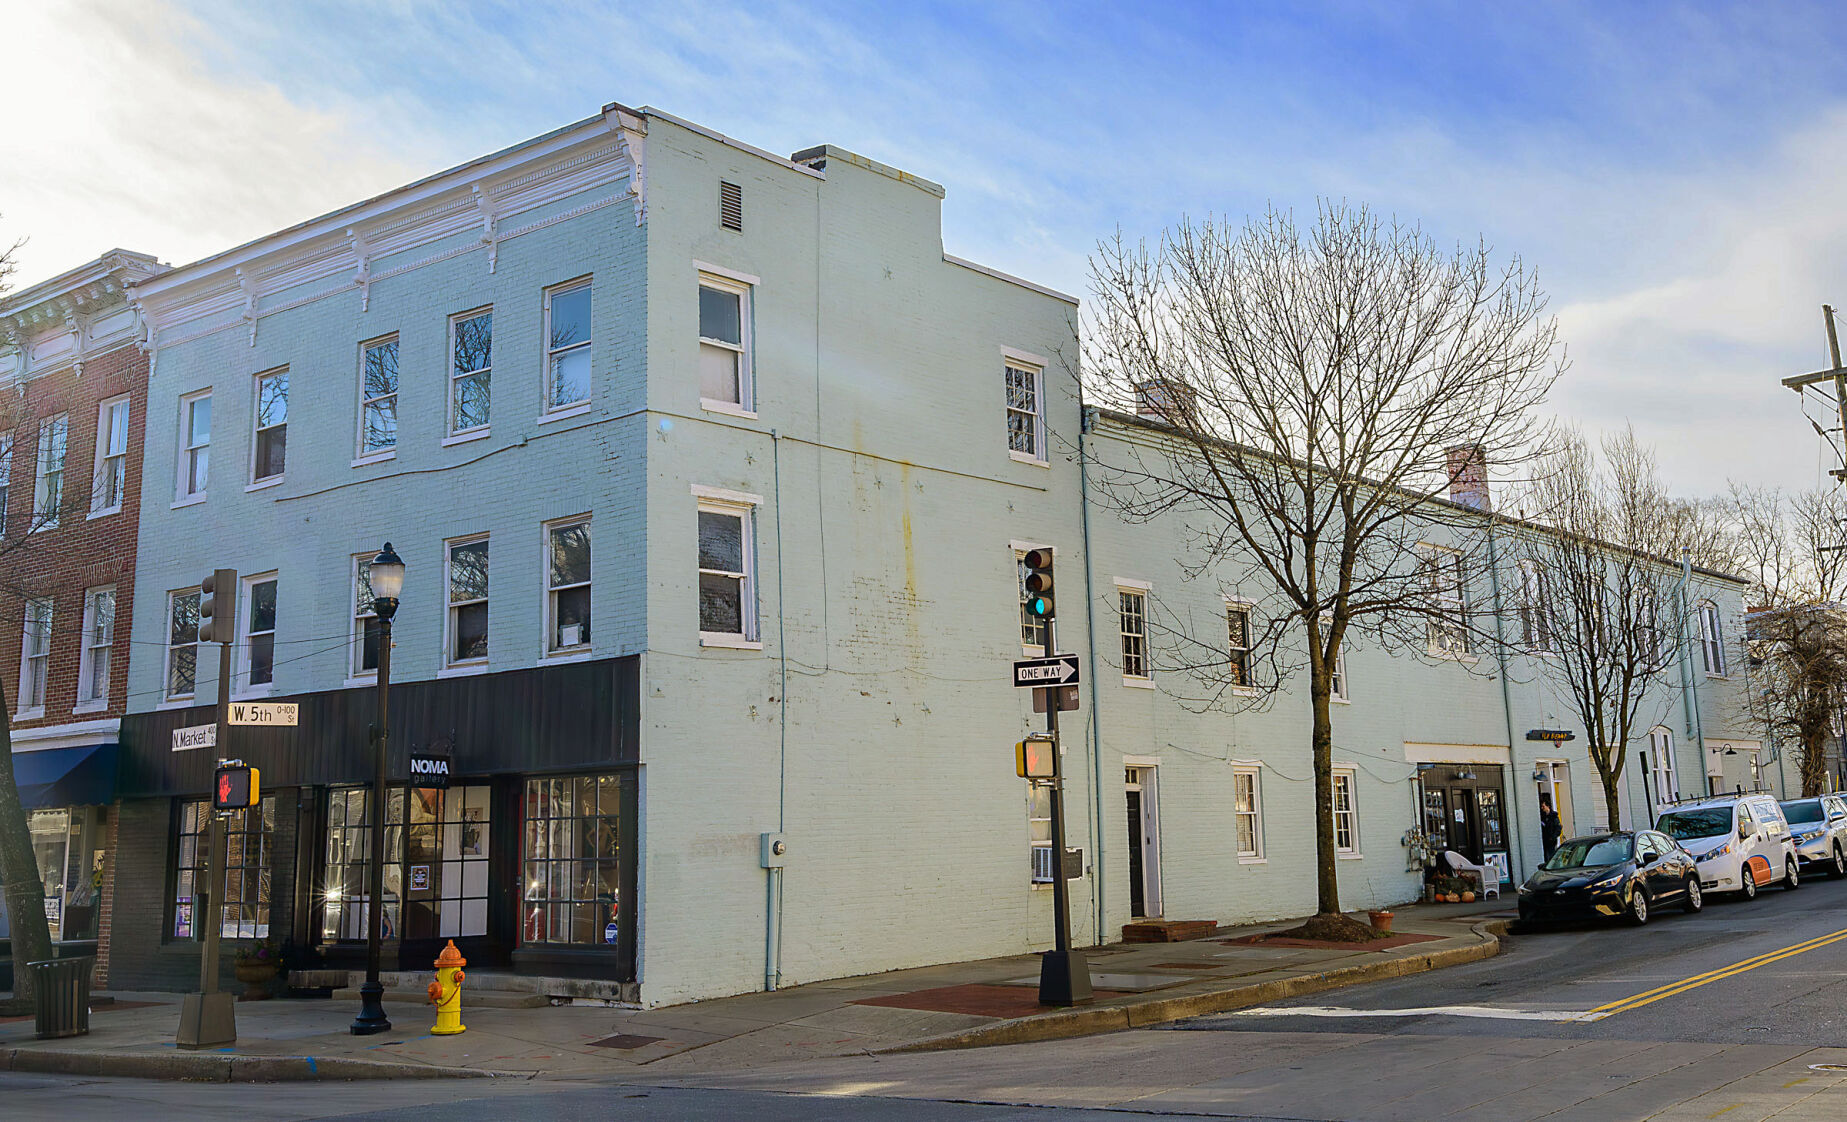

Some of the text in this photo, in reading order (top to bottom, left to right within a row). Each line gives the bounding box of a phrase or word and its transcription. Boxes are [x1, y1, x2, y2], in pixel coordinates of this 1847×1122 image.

[1022, 667, 1061, 679] ONE WAY
[234, 706, 272, 722] W. 5th
[411, 759, 449, 774] NOMA
[415, 775, 446, 784] gallery
